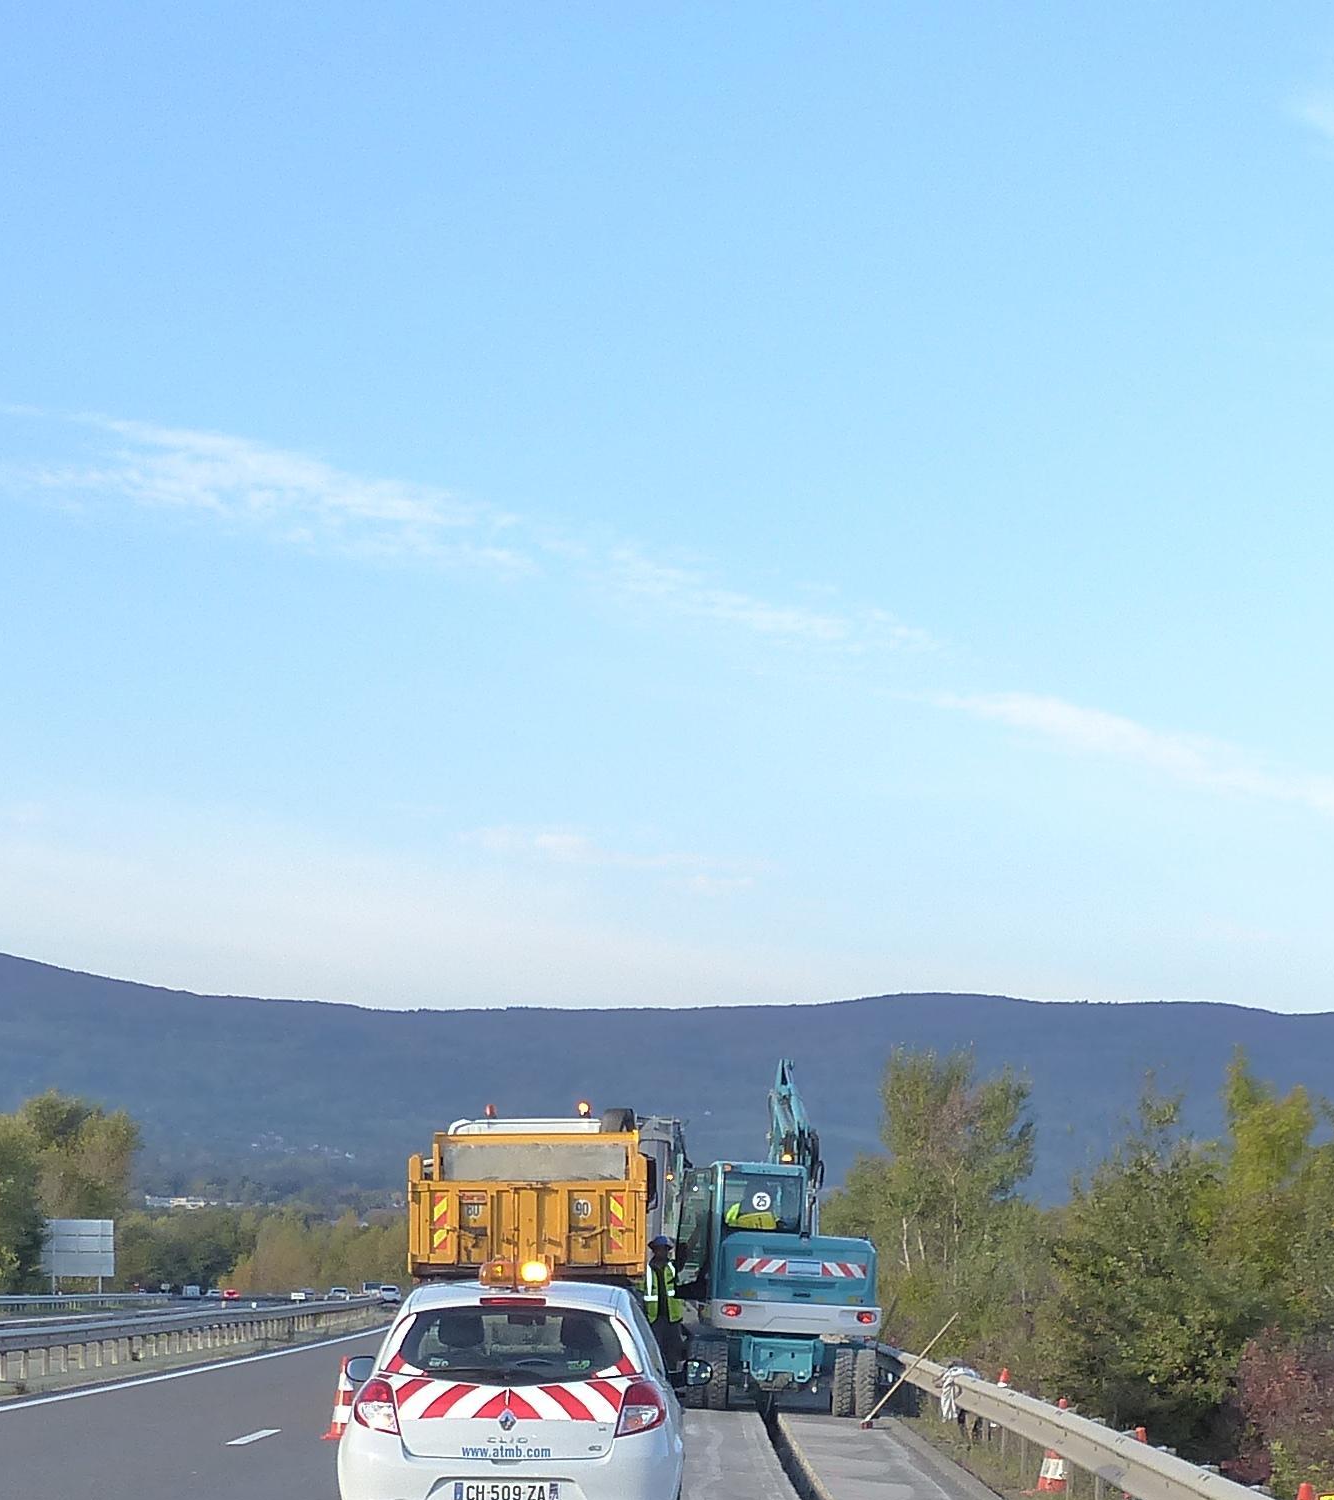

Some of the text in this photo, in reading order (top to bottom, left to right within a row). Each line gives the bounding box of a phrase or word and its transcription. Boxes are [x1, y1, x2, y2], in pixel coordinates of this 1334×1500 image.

[756, 1195, 767, 1207] 25
[575, 1201, 589, 1216] 90
[461, 1445, 551, 1458] www.atmb.com
